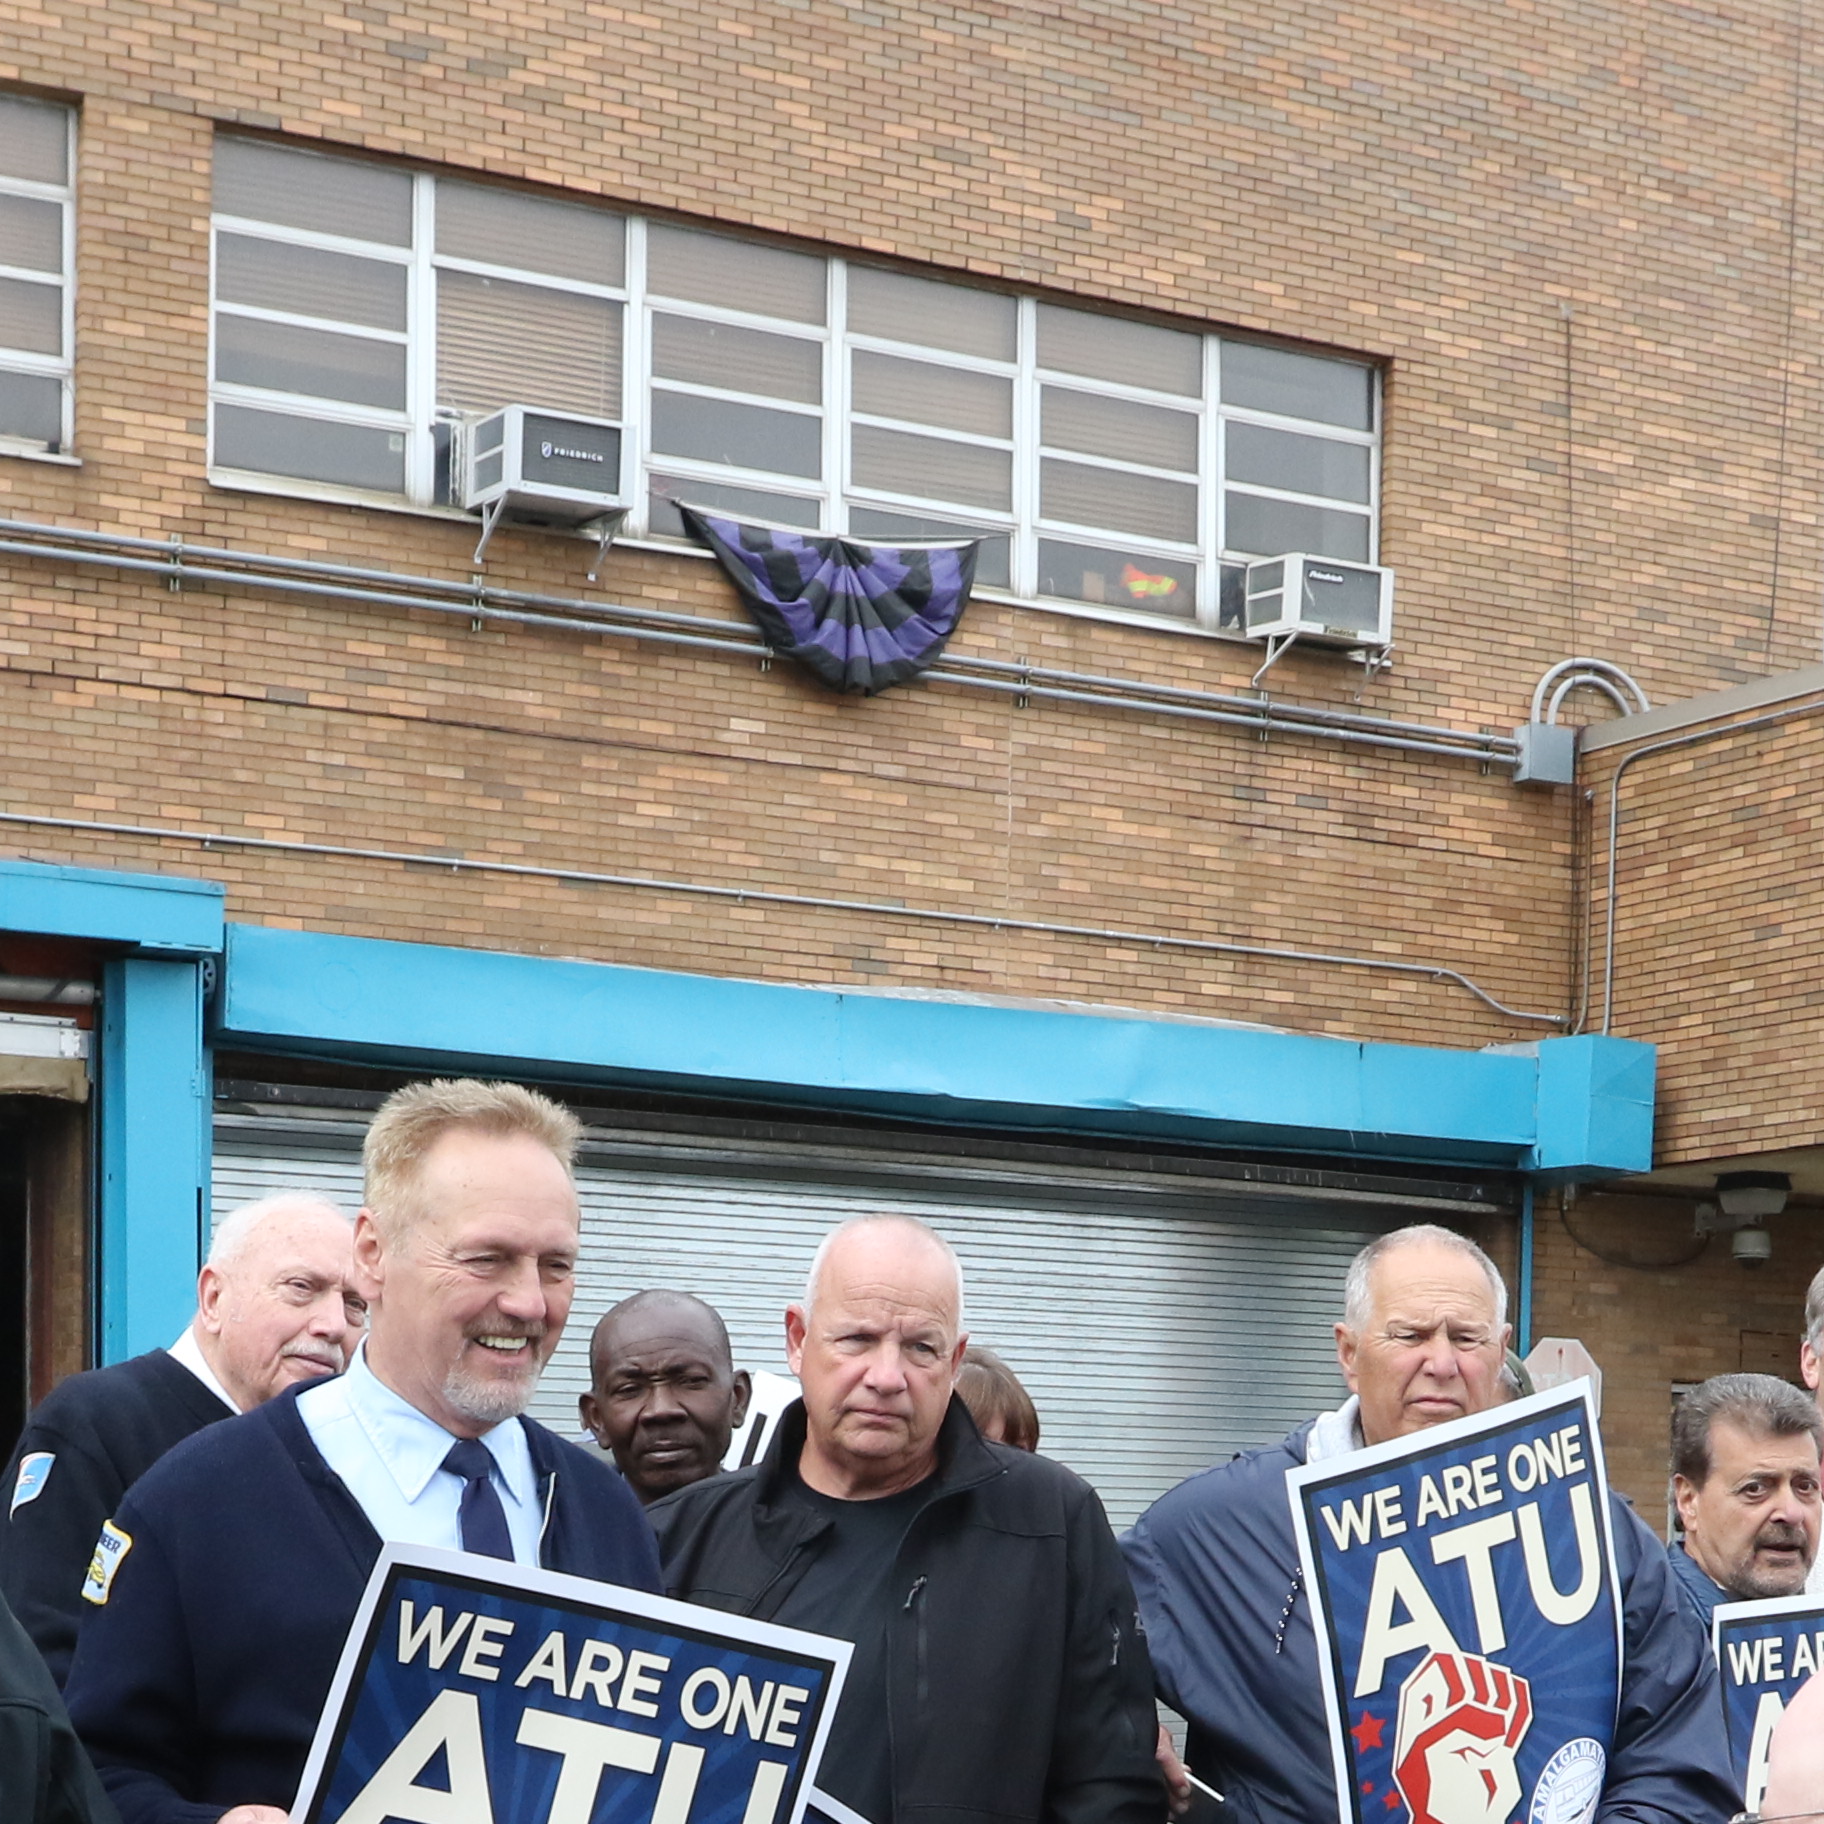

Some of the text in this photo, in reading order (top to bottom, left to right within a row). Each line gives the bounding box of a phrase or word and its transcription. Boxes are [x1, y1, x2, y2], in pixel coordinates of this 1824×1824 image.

[554, 447, 604, 463] FRIEDRICH
[1320, 1424, 1586, 1553] WE ARE ONE
[1353, 1481, 1603, 1699] ATU
[396, 1598, 810, 1748] WE ARE ONE
[1727, 1636, 1785, 1686] WE
